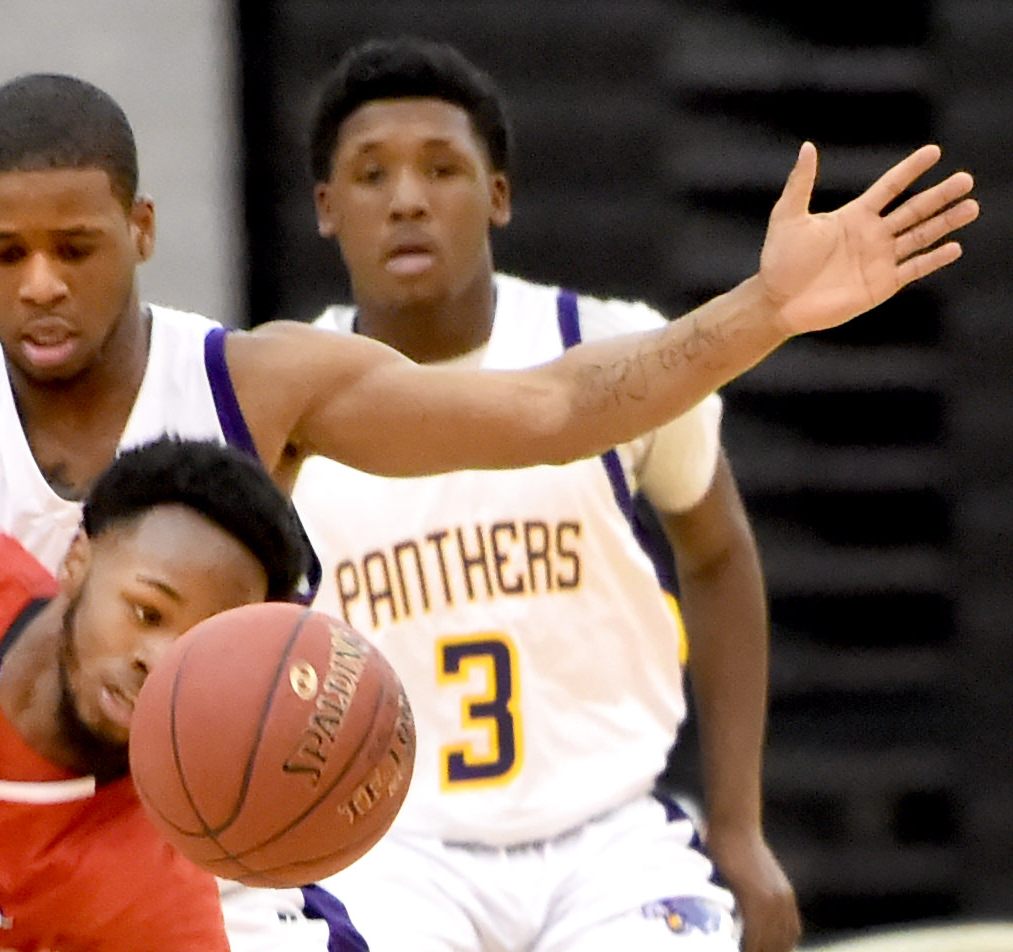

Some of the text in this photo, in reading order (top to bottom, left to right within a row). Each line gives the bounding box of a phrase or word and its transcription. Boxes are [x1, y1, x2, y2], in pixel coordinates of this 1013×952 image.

[335, 519, 585, 633] PANTHERS
[282, 622, 371, 788] SPALDIN
[436, 630, 526, 795] 3
